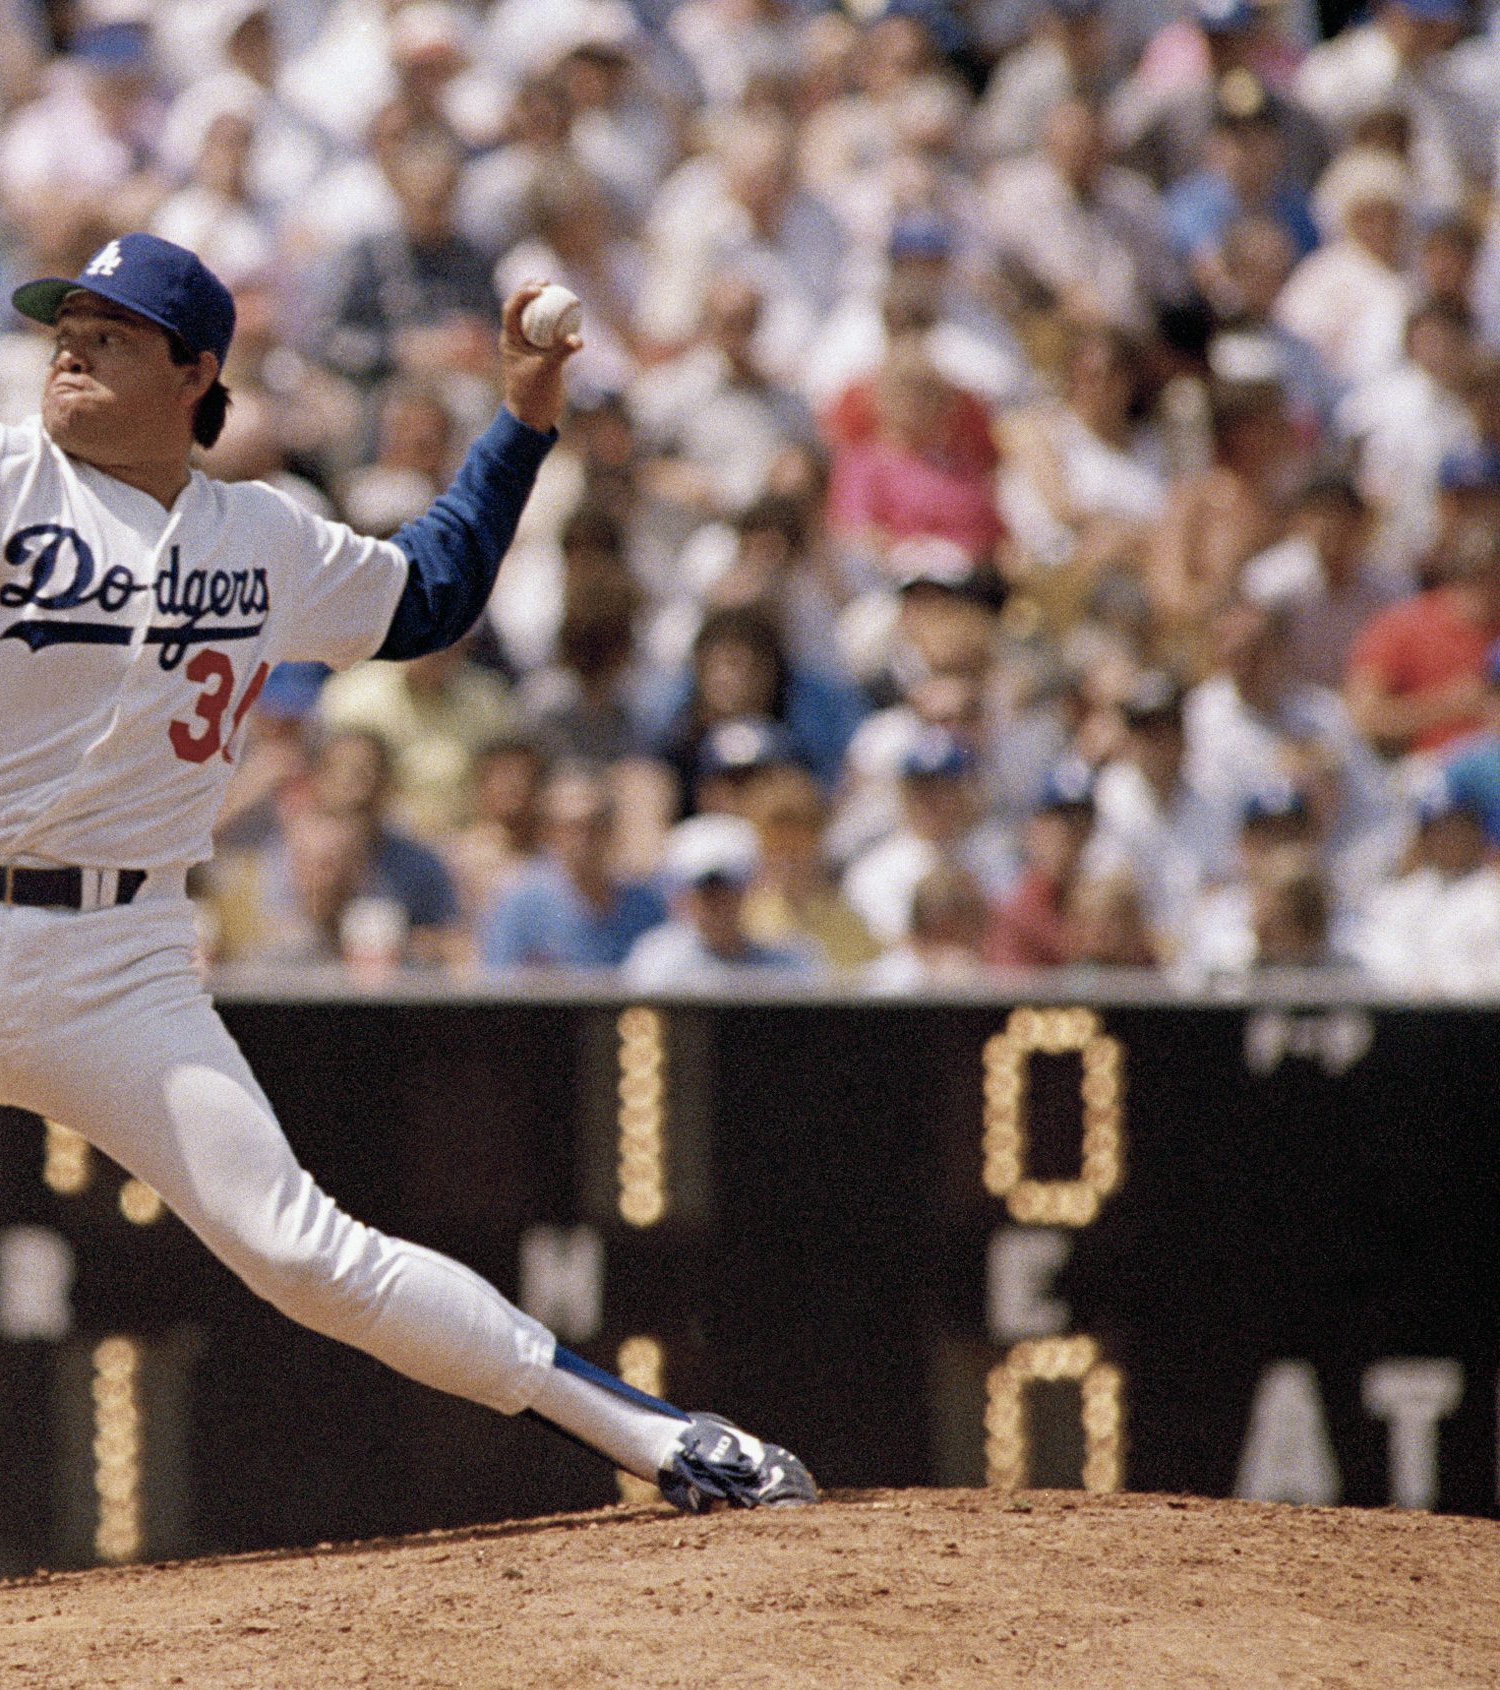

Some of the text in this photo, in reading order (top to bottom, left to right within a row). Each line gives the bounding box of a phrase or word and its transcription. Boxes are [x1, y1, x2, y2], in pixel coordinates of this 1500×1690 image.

[0, 523, 270, 671] Dodgers
[982, 1006, 1126, 1228] 0
[987, 1226, 1072, 1343] E
[1234, 1356, 1466, 1509] AT
